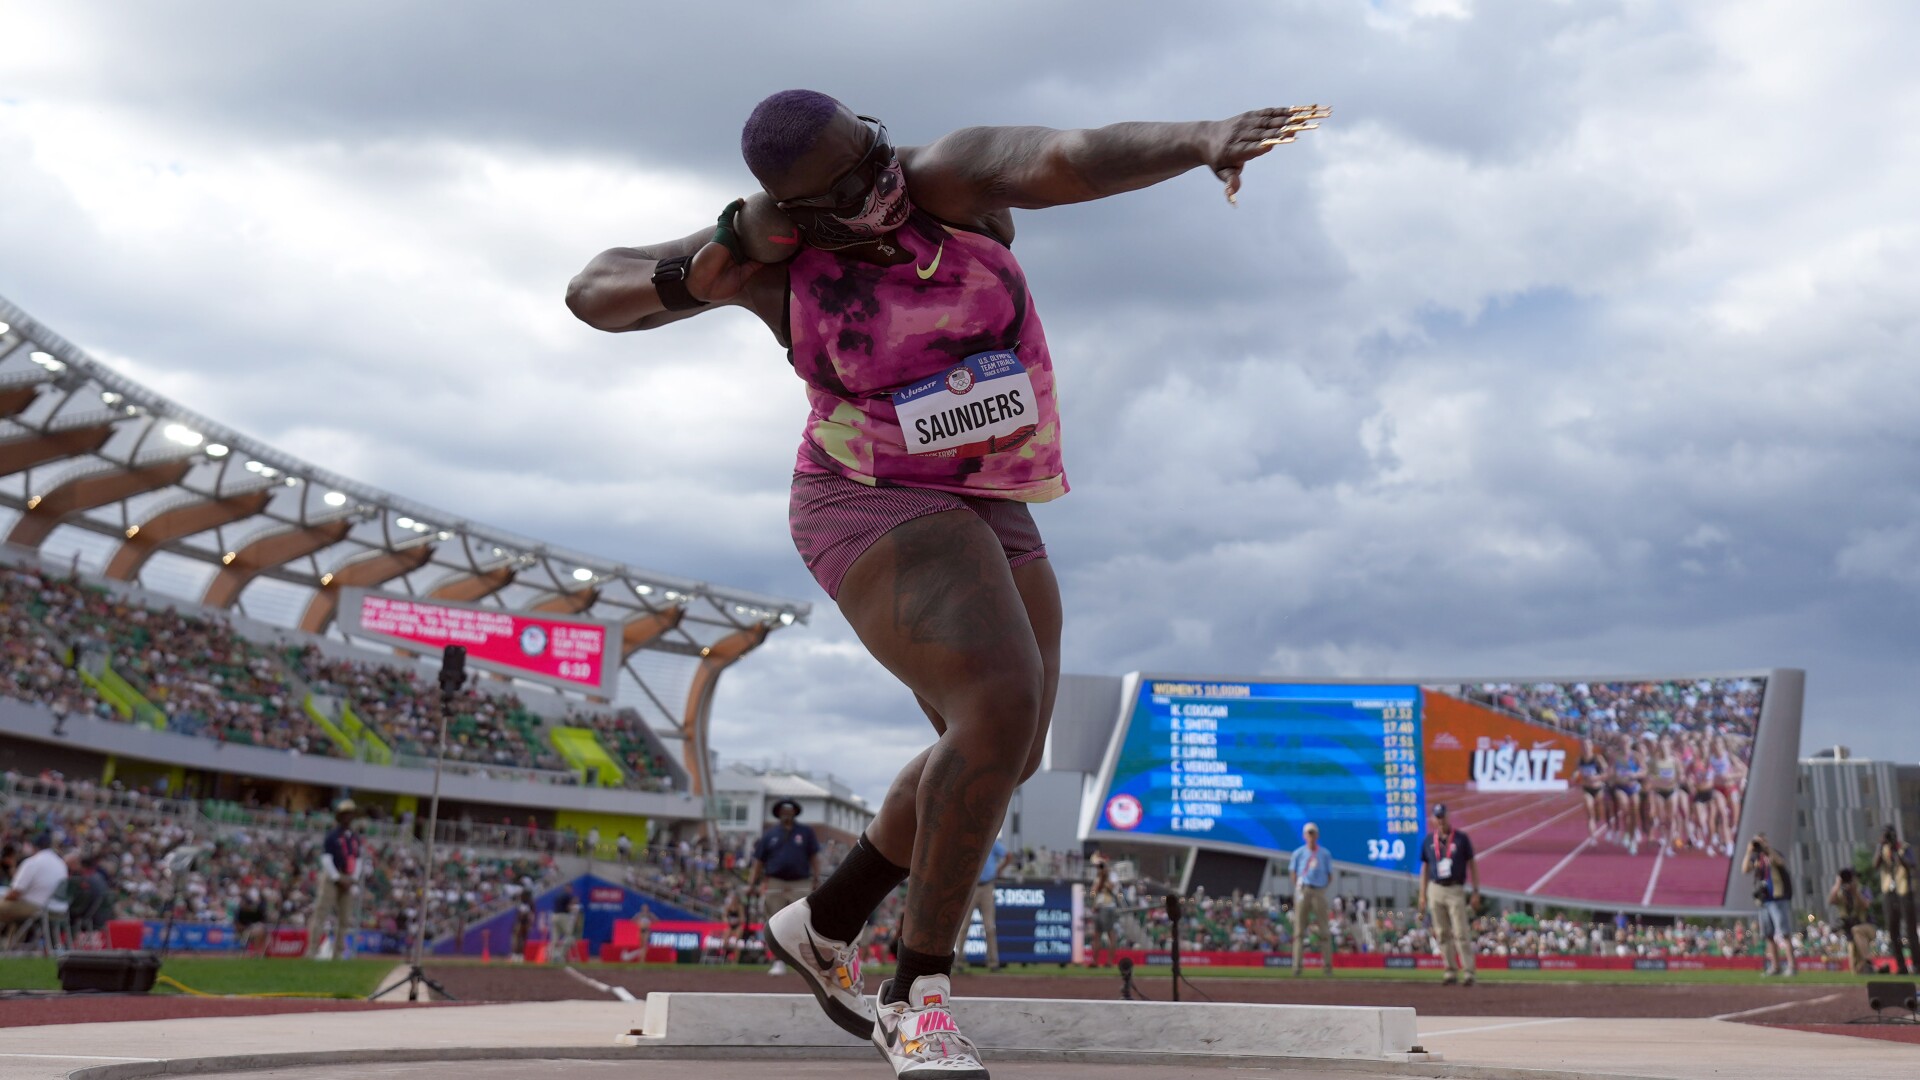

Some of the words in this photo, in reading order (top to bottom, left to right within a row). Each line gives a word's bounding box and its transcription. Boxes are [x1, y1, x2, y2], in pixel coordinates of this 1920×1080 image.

[977, 356, 989, 365] U.S.
[990, 353, 1012, 362] OLYMPIC
[980, 363, 997, 373] TEAM
[997, 358, 1016, 367] TRIALS
[1000, 365, 1010, 373] FIELD
[912, 380, 937, 395] USATF
[915, 389, 1025, 445] SAUNDERS
[1153, 683, 1203, 696] WOMEN'S
[1183, 704, 1228, 718] COOGAN
[1183, 718, 1217, 731] SMITH
[1182, 746, 1217, 759] LIPARI
[1473, 748, 1566, 781] USATF
[1184, 774, 1243, 788] SCHWEIZER
[1183, 818, 1215, 831] KEMP
[1367, 839, 1406, 861] 32.0
[1004, 888, 1045, 907] DISCUS
[925, 995, 941, 1004] NIKE
[915, 1010, 958, 1036] NIKE
